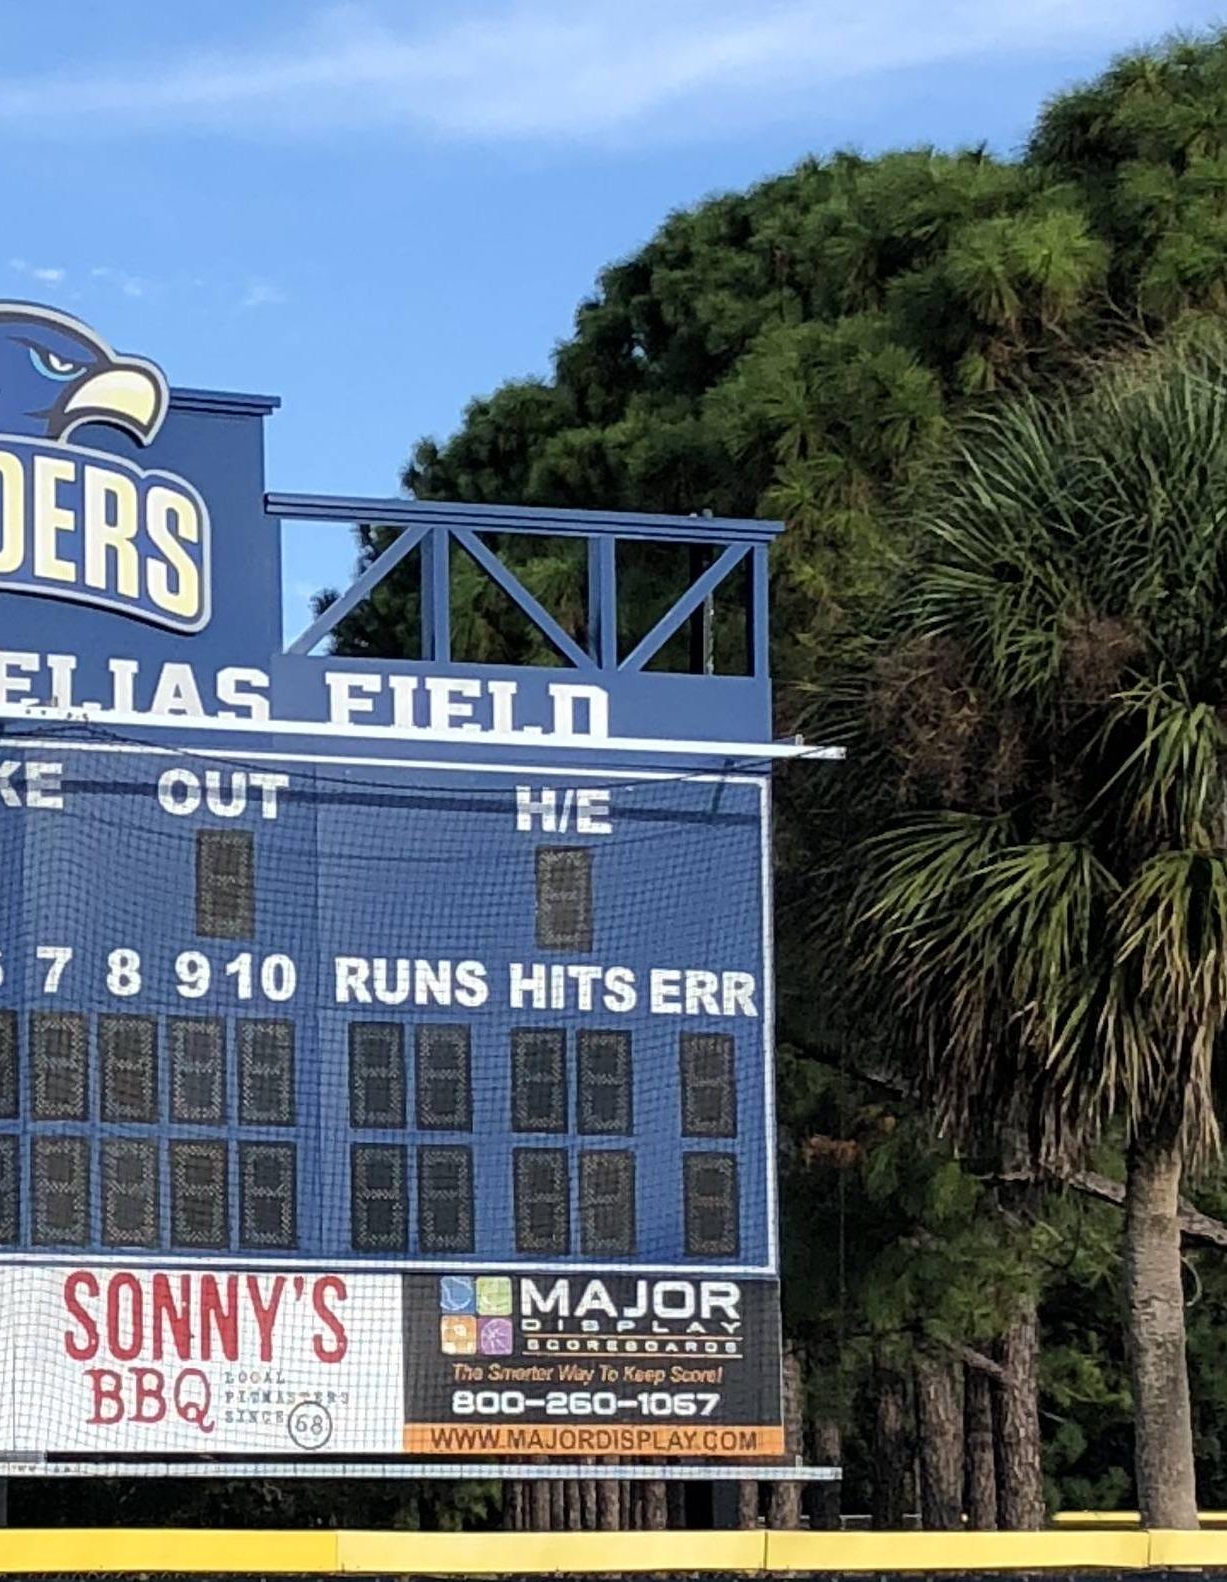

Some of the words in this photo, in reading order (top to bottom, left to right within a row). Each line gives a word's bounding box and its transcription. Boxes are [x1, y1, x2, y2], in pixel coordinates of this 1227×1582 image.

[325, 671, 610, 738] FIELD
[157, 768, 290, 820] OUT
[515, 786, 613, 835] H/E
[36, 946, 73, 993] 7
[106, 948, 142, 996] 8
[174, 951, 212, 998] 9
[225, 952, 297, 1001] 10
[334, 957, 490, 1009] RUNS
[509, 963, 638, 1013] HITS
[650, 968, 759, 1017] ERR
[520, 1278, 741, 1320] MAJOR
[64, 1270, 348, 1363] SONNY'S
[521, 1318, 742, 1335] DISPLAY
[526, 1338, 738, 1354] SCOREBOARDS
[224, 1371, 286, 1385] LOCAL
[453, 1363, 483, 1381] The
[487, 1363, 554, 1383] Smarter
[558, 1364, 595, 1386] Way
[599, 1365, 619, 1382] To
[623, 1366, 666, 1385] Keep
[670, 1366, 723, 1383] Score!
[84, 1367, 215, 1433] BBQ
[224, 1410, 285, 1424] SINCE
[451, 1390, 721, 1416] 800-260-1067
[430, 1427, 757, 1451] WWW.MAJORDISPLAY.COM
